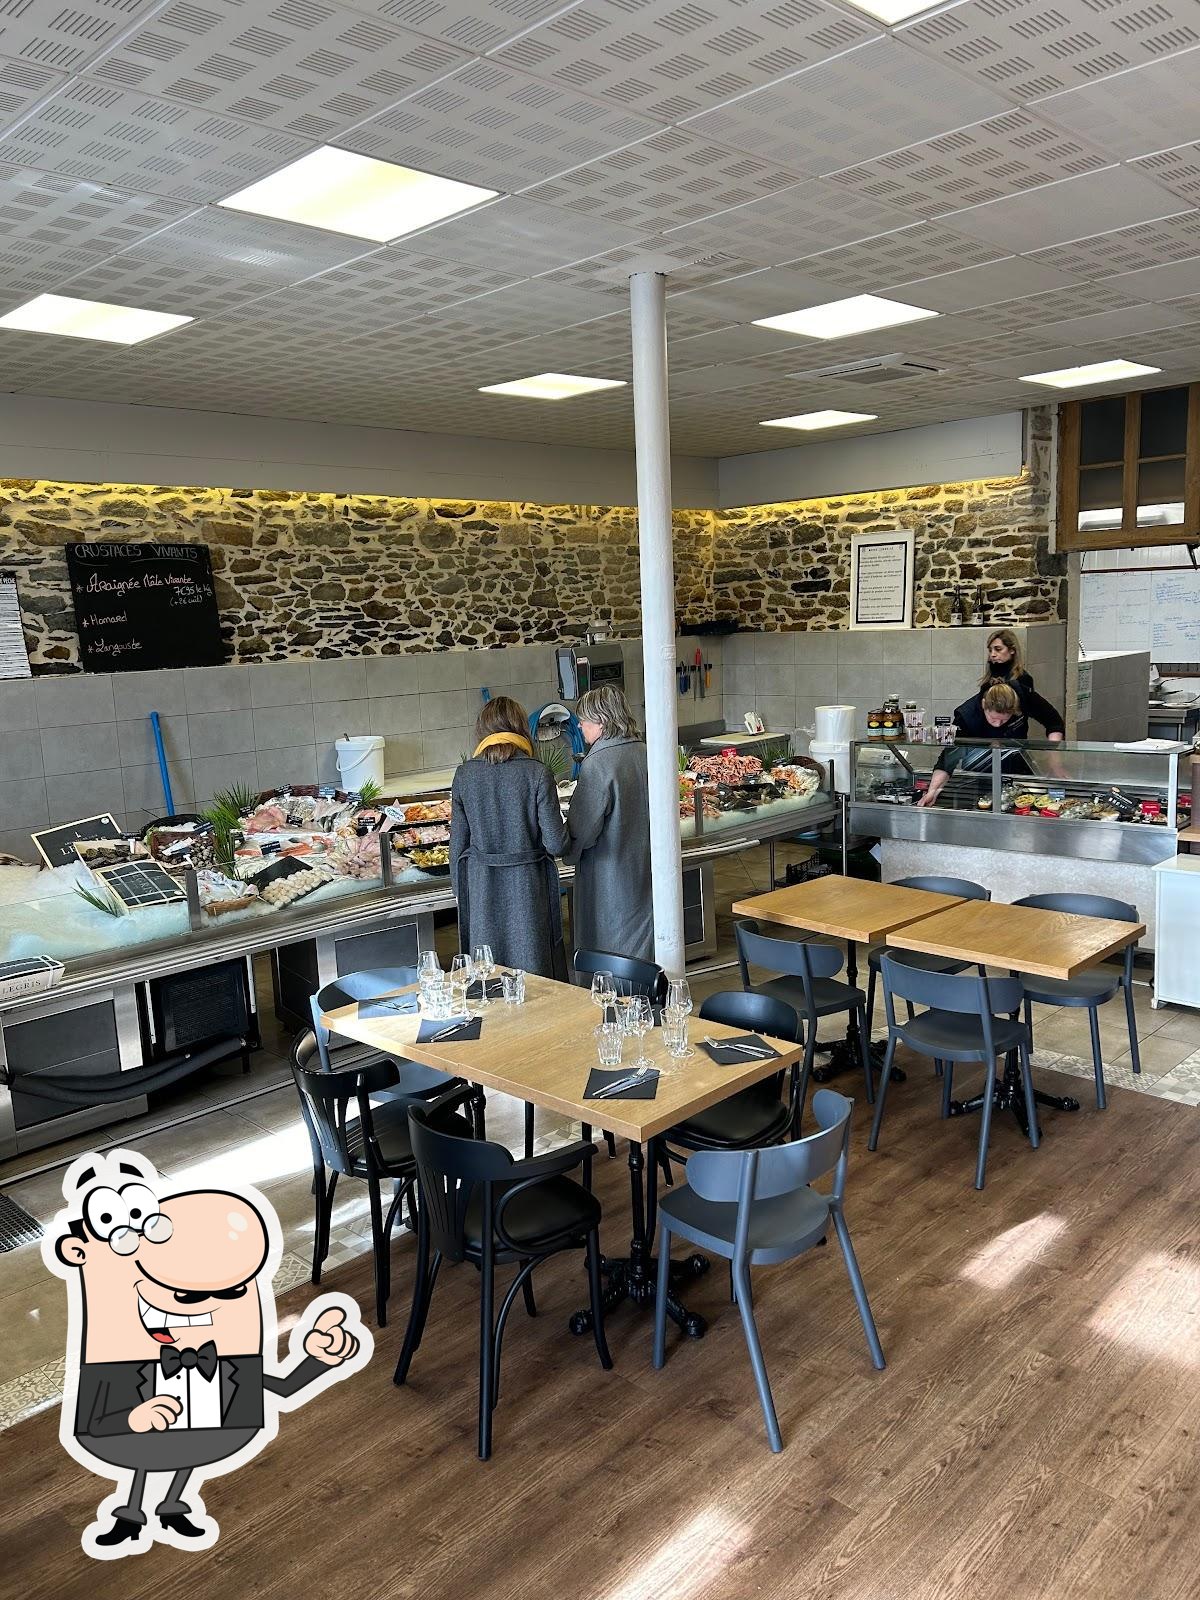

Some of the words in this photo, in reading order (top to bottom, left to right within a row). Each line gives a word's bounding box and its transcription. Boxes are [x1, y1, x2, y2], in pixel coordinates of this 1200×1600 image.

[150, 545, 198, 559] VIVANTS
[90, 610, 127, 625] Homard
[2, 981, 41, 994] LEGRIS
